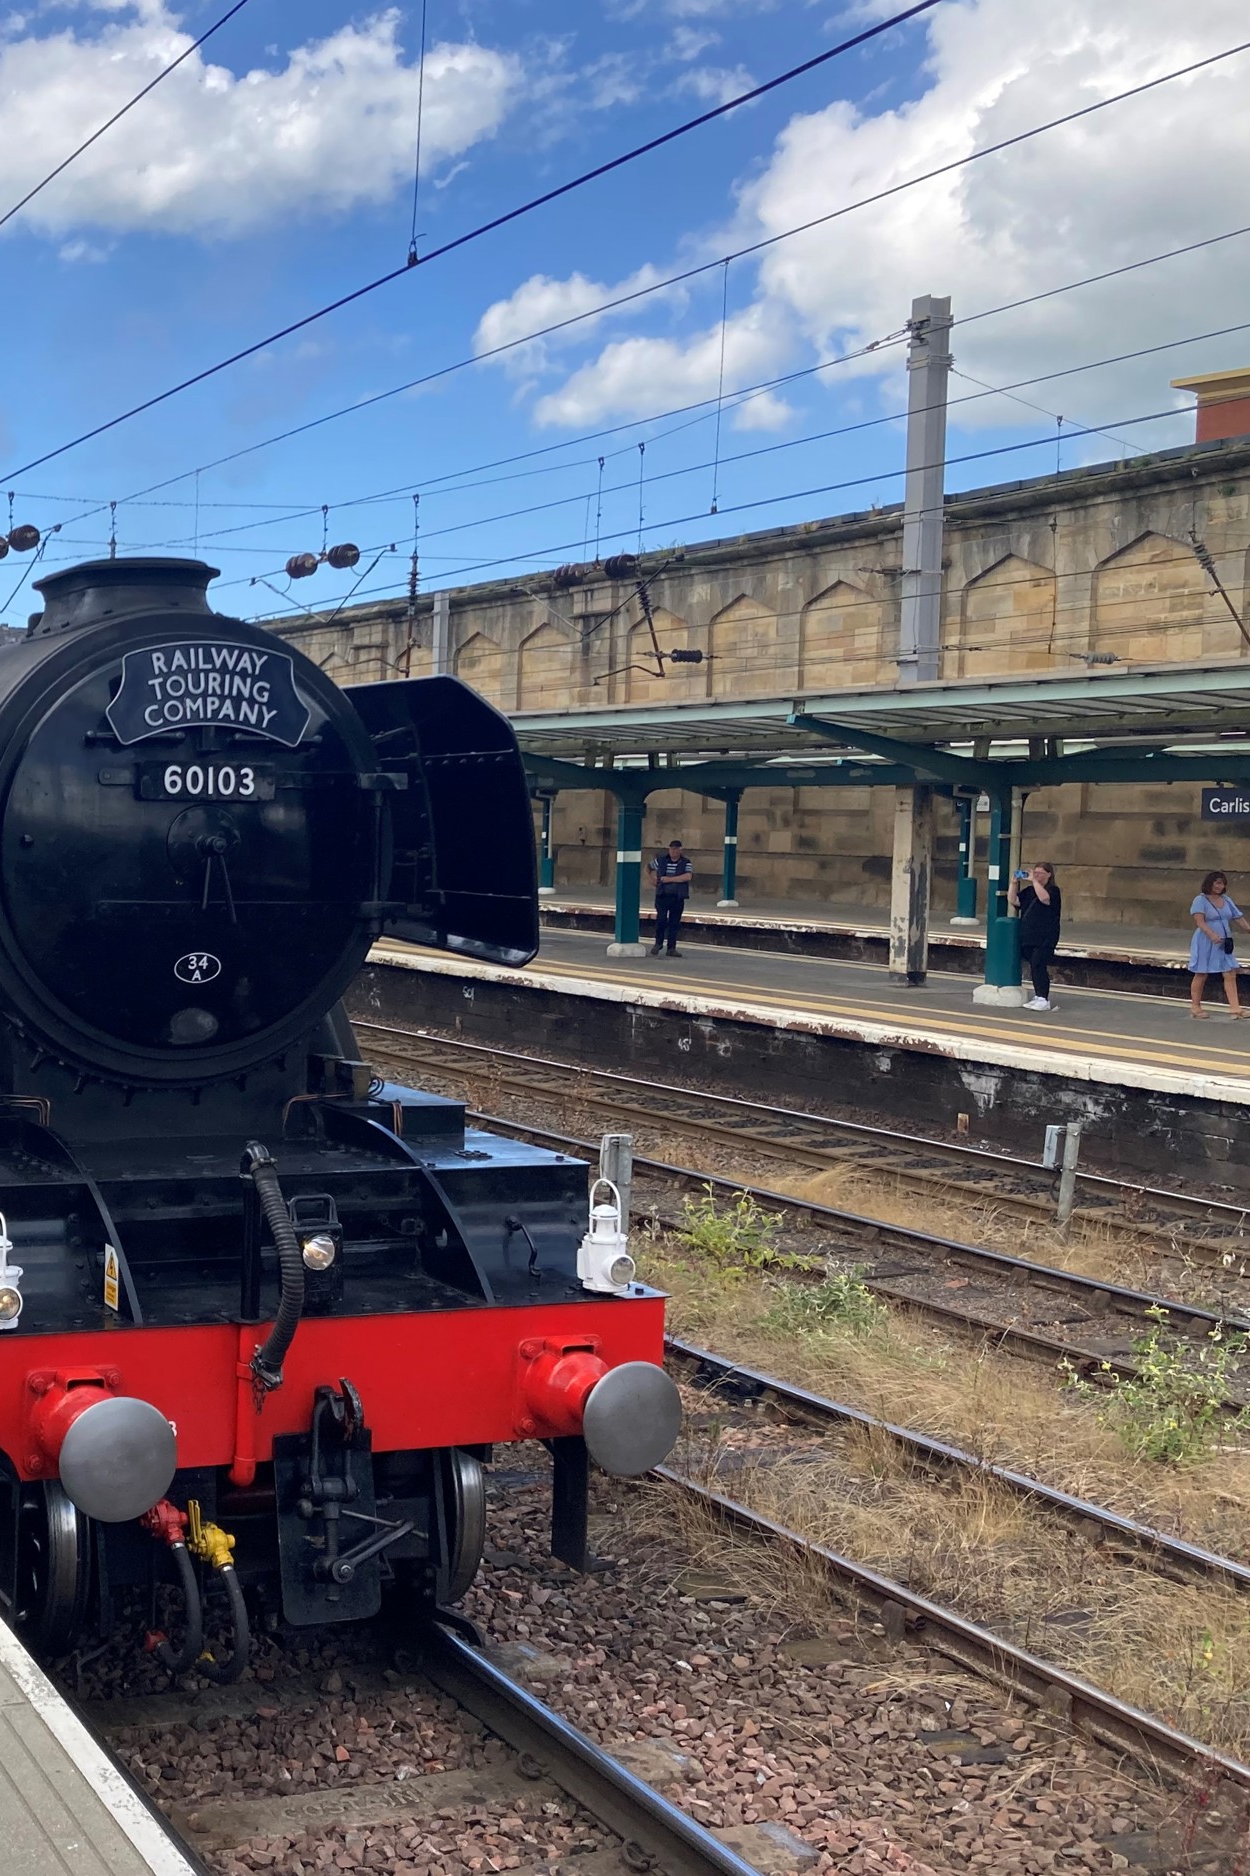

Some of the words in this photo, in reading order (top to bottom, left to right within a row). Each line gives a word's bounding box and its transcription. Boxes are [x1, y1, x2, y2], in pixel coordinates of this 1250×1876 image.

[151, 647, 269, 675] RAILWAY
[147, 671, 271, 703] TOURING
[143, 696, 278, 728] COMPANY
[164, 765, 255, 795] 60103
[1209, 797, 1250, 813] Carlis
[188, 955, 209, 970] 34
[191, 969, 202, 981] A
[281, 1786, 421, 1820] COSTAIN
